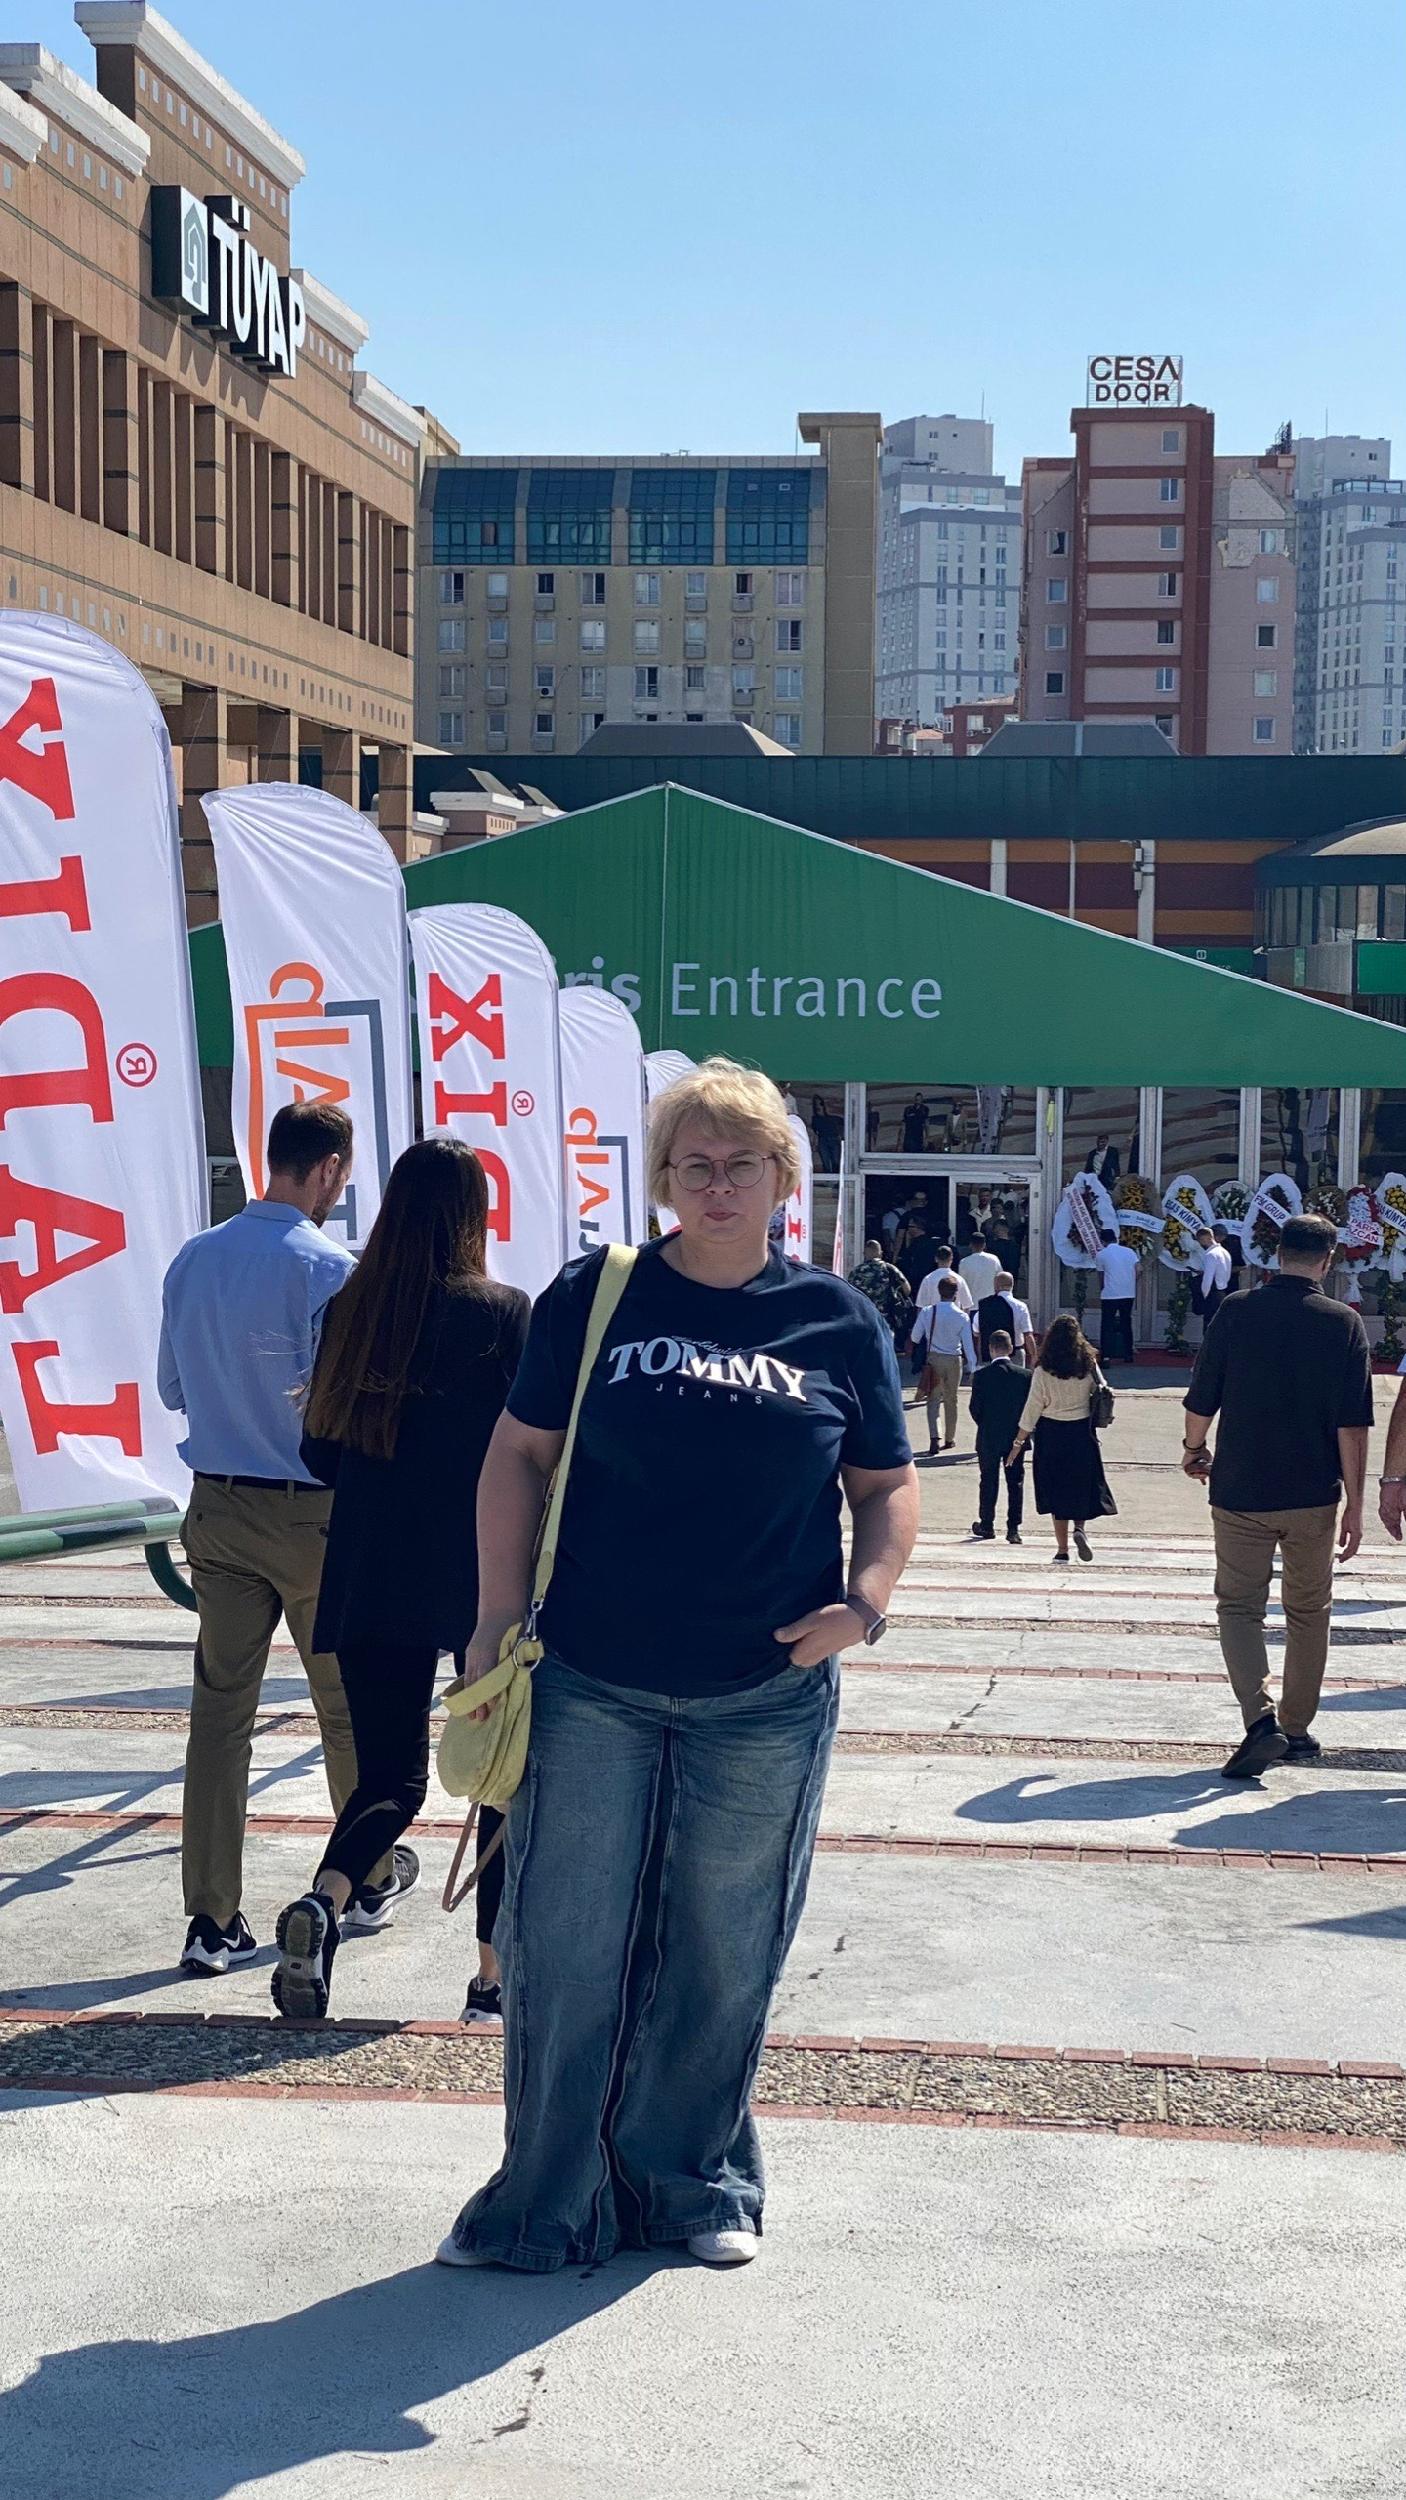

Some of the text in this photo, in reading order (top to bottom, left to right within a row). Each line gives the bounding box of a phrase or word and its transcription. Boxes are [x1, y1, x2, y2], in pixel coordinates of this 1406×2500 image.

[212, 195, 306, 379] TÜYAP
[1090, 356, 1179, 381] CESA
[1095, 383, 1170, 402] DOOR
[671, 962, 942, 1019] Entrance
[1265, 1202, 1286, 1220] GRUP
[608, 1336, 806, 1402] TOMMY
[656, 1383, 762, 1404] JEANS
